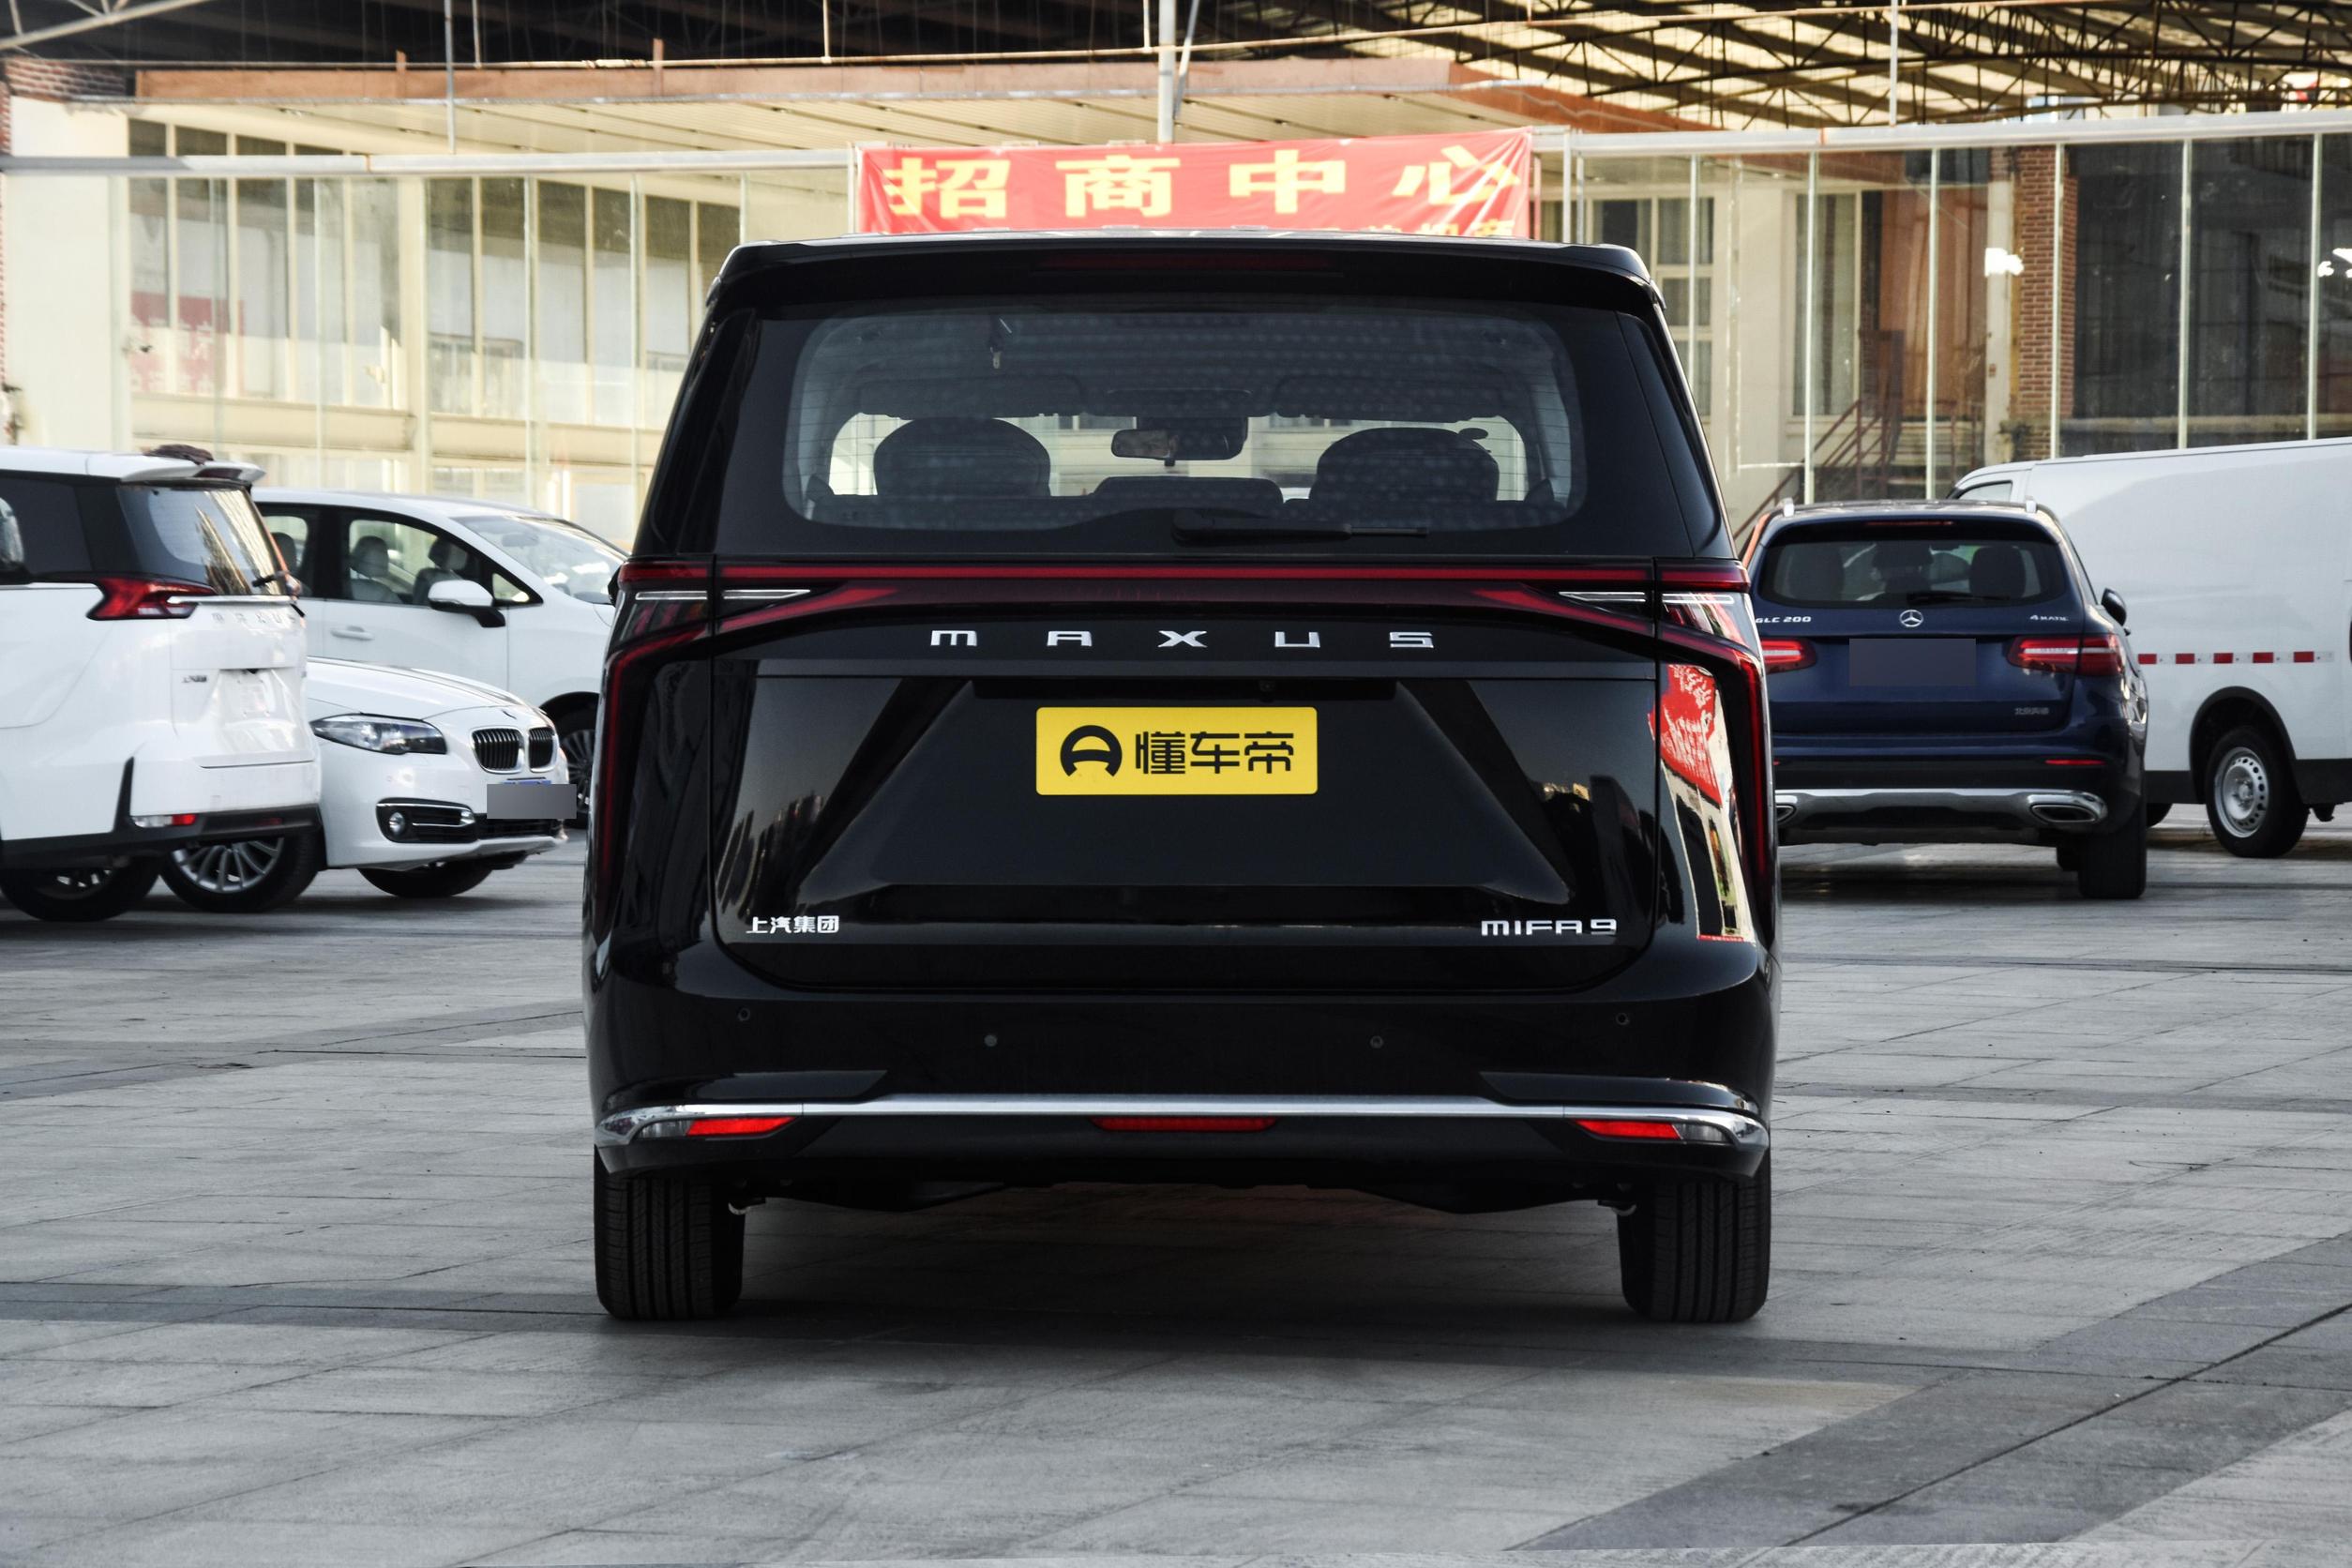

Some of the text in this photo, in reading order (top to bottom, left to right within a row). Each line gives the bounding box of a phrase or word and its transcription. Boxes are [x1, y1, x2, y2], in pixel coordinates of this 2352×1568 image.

[882, 145, 1521, 219] 招商中心
[930, 630, 1434, 648] MAXUS
[1135, 731, 1293, 775] 懂车帝
[746, 915, 839, 934] 上汽集团
